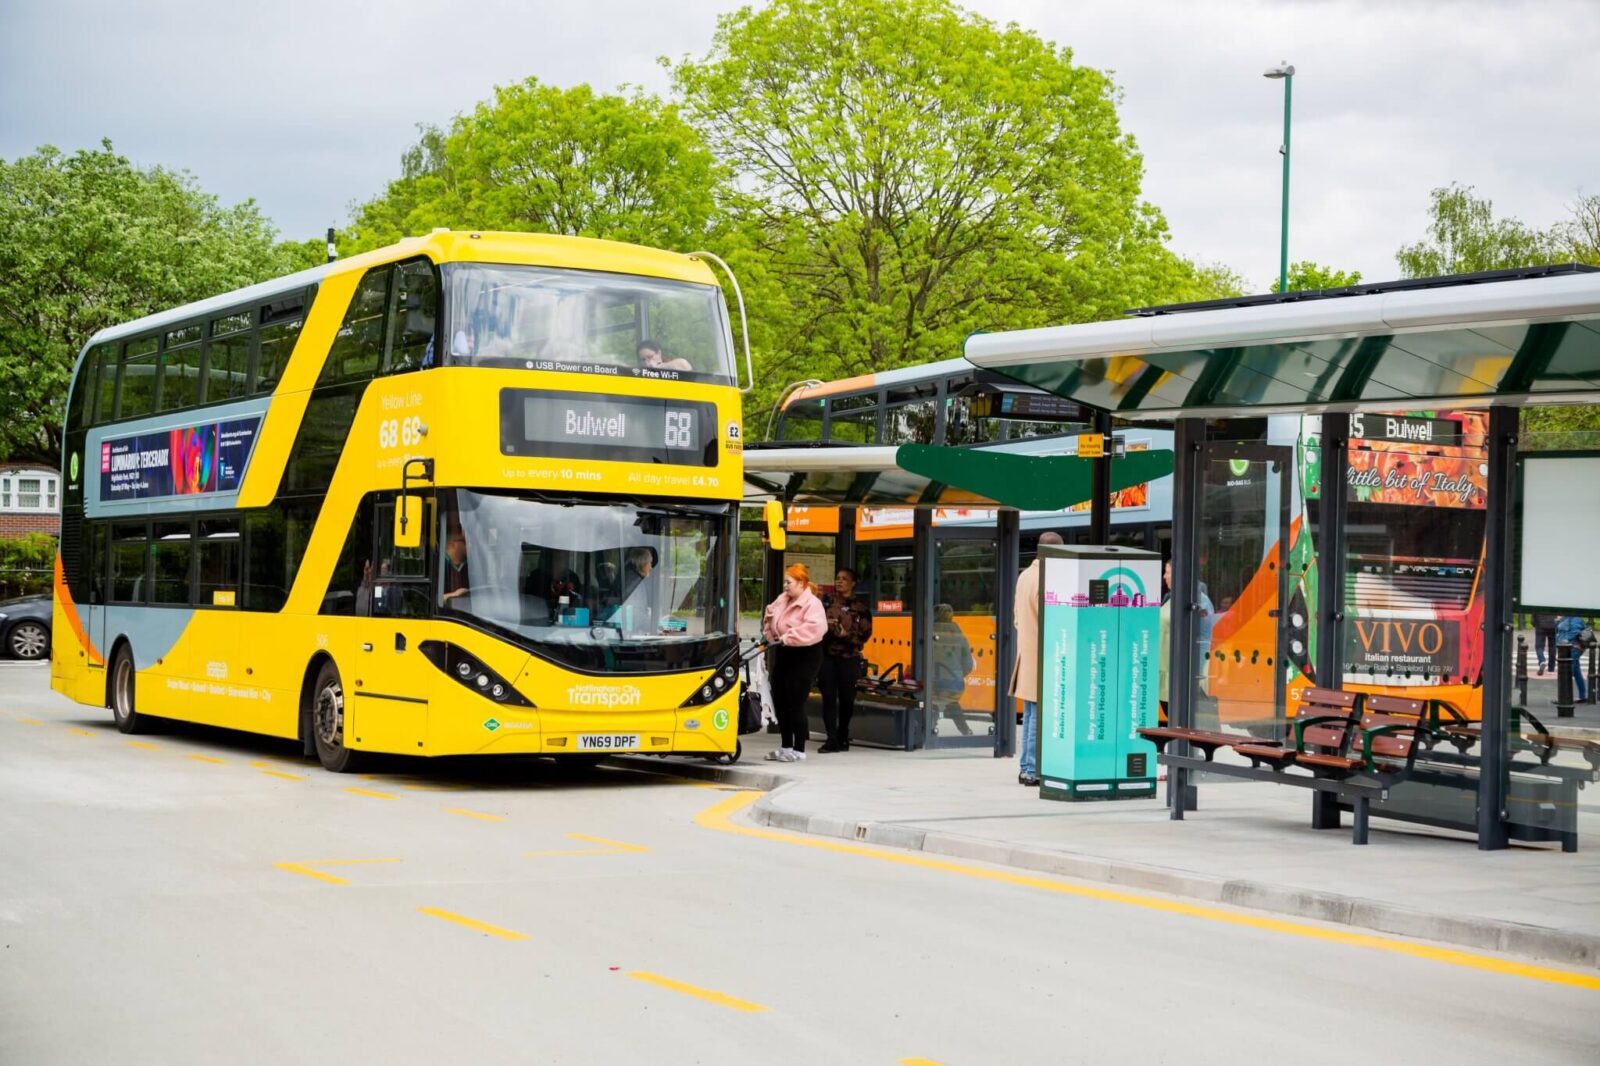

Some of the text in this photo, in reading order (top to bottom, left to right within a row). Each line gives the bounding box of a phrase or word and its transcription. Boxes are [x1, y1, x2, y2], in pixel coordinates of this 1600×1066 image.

[535, 361, 618, 374] USB Power on Board
[642, 369, 679, 380] Free Wi-Fi
[381, 391, 423, 410] Yellow Line
[379, 416, 421, 448] 68 69
[565, 409, 626, 439] Bulwell
[664, 411, 692, 447] 68
[729, 426, 739, 438] £2
[1349, 413, 1432, 441] 5 Bulwell
[528, 469, 558, 480] every
[560, 469, 574, 479] 10
[576, 470, 602, 481] mins
[628, 472, 641, 482] All
[644, 473, 661, 485] day
[664, 473, 690, 484] travel
[1385, 467, 1408, 488] bit
[1411, 472, 1431, 498] of
[1099, 629, 1107, 655] here!
[1141, 629, 1149, 655] here!
[1354, 620, 1443, 654] VIVO
[1140, 656, 1148, 682] cards
[1391, 655, 1432, 664] restaurant
[1088, 643, 1098, 740] Buy and top-up your
[1130, 667, 1139, 699] top-up
[567, 688, 641, 709] Transport
[1098, 685, 1106, 710] Hood
[1129, 700, 1137, 718] and
[582, 736, 637, 748] YN69 DPF
[1129, 721, 1138, 739] Buy
